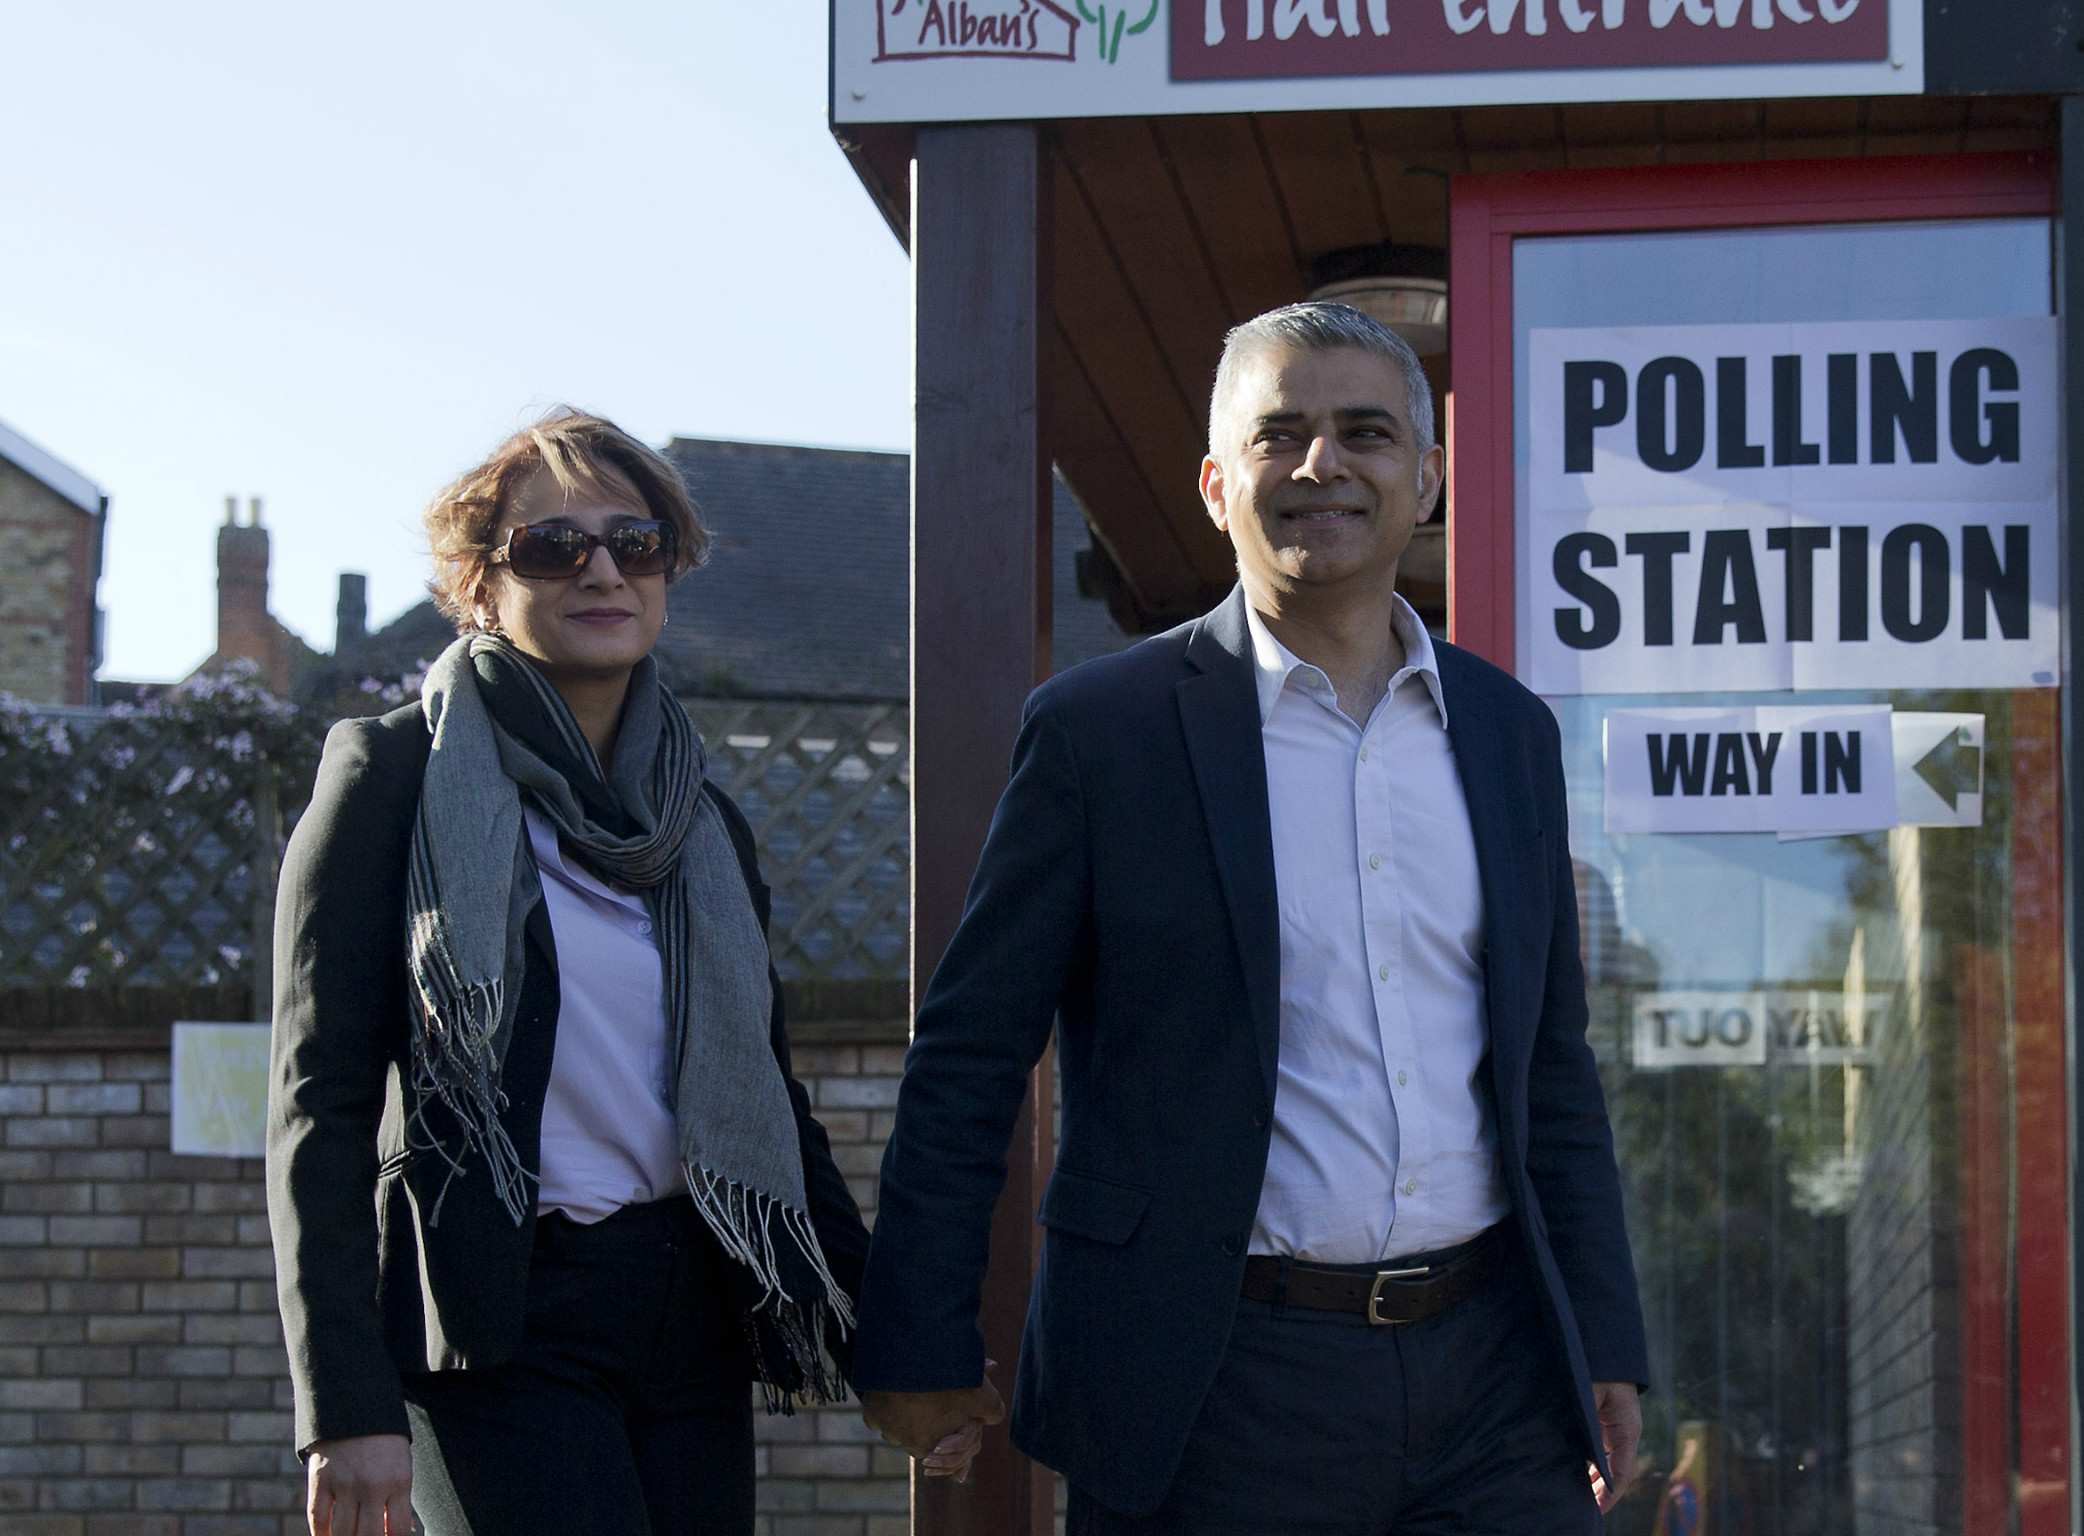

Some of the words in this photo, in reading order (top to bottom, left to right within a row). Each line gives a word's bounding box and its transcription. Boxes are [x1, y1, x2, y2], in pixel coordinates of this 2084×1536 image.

[1563, 347, 2020, 473] POLLING
[1552, 523, 2030, 650] STATION
[1646, 731, 1782, 796] WAY
[1800, 731, 1862, 794] IN
